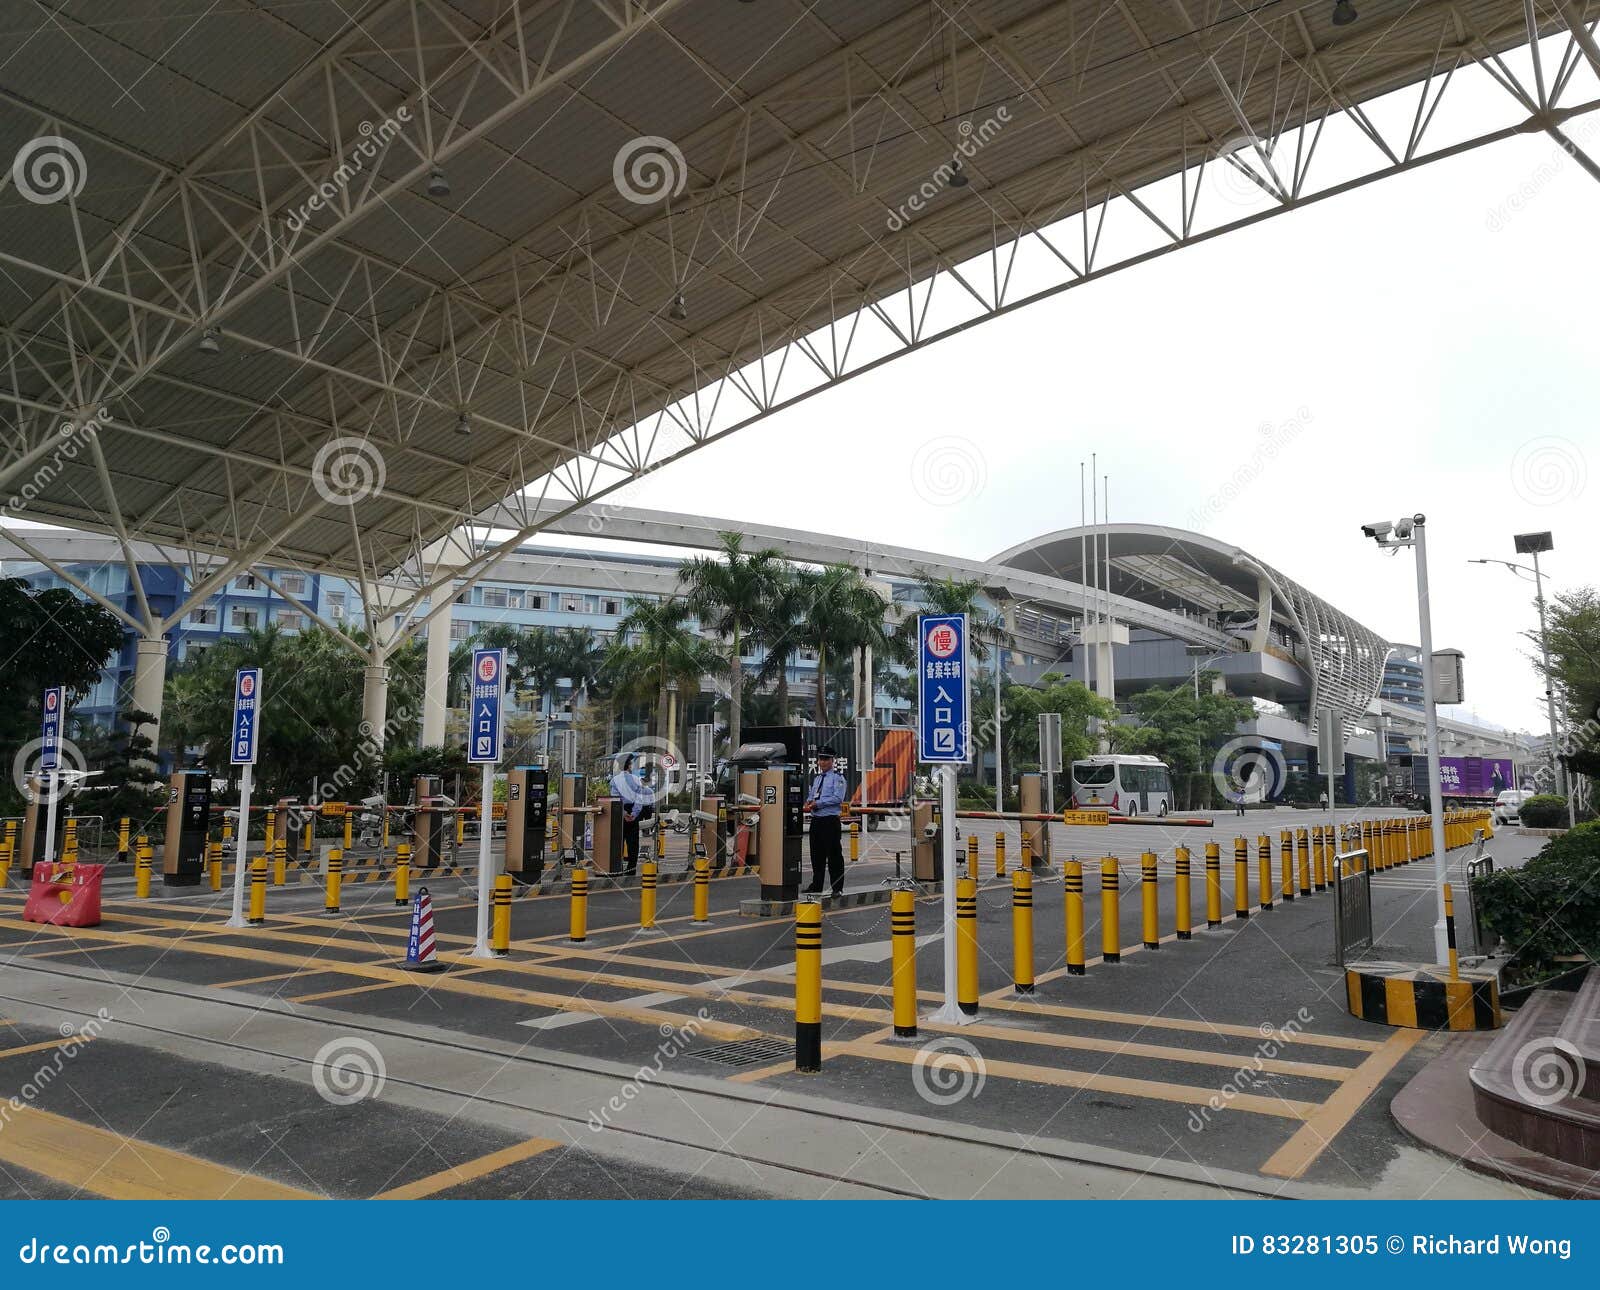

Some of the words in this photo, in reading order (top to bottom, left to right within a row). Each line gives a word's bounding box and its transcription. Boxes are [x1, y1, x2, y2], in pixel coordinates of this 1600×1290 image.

[933, 630, 952, 651] 慢
[926, 660, 961, 679] 备案车辆
[933, 685, 953, 724] 入口
[240, 714, 250, 739] 入口
[479, 703, 493, 733] 入口
